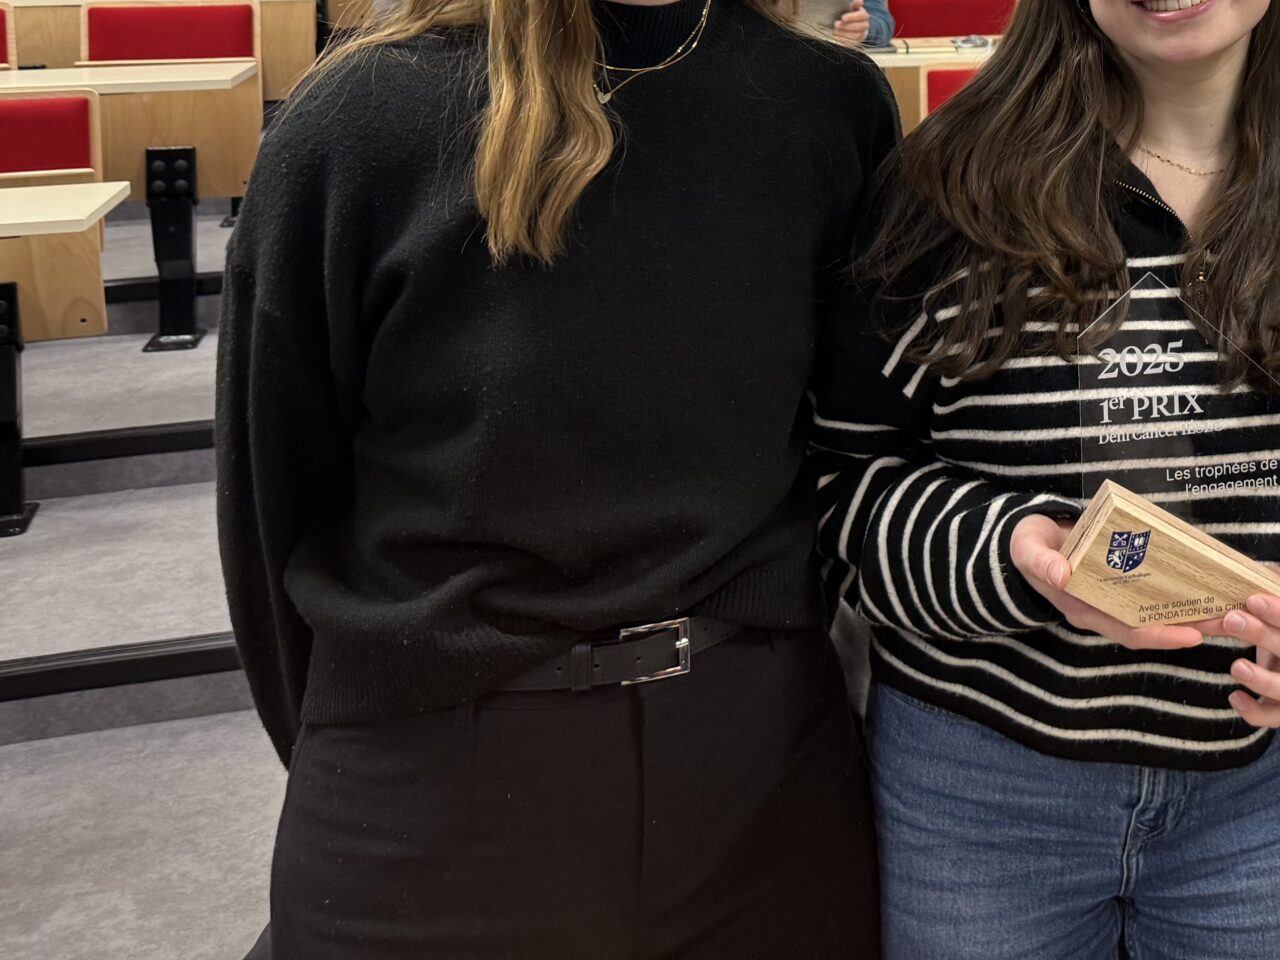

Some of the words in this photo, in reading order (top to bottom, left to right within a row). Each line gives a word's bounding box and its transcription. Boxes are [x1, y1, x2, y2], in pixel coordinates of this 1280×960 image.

[1097, 340, 1184, 379] 2025
[1100, 395, 1127, 423] 1er
[1128, 392, 1204, 420] PRIX
[1166, 468, 1191, 481] Les
[1195, 461, 1257, 479] trophées
[1260, 458, 1278, 470] de
[1185, 474, 1278, 496] l'engagement
[1138, 604, 1160, 613] Avec
[1162, 602, 1169, 610] le
[1171, 598, 1201, 609] soutien
[1204, 596, 1215, 604] de
[1139, 615, 1146, 623] la
[1148, 609, 1201, 622] FONDATION
[1202, 606, 1213, 614] de
[1215, 605, 1222, 613] la
